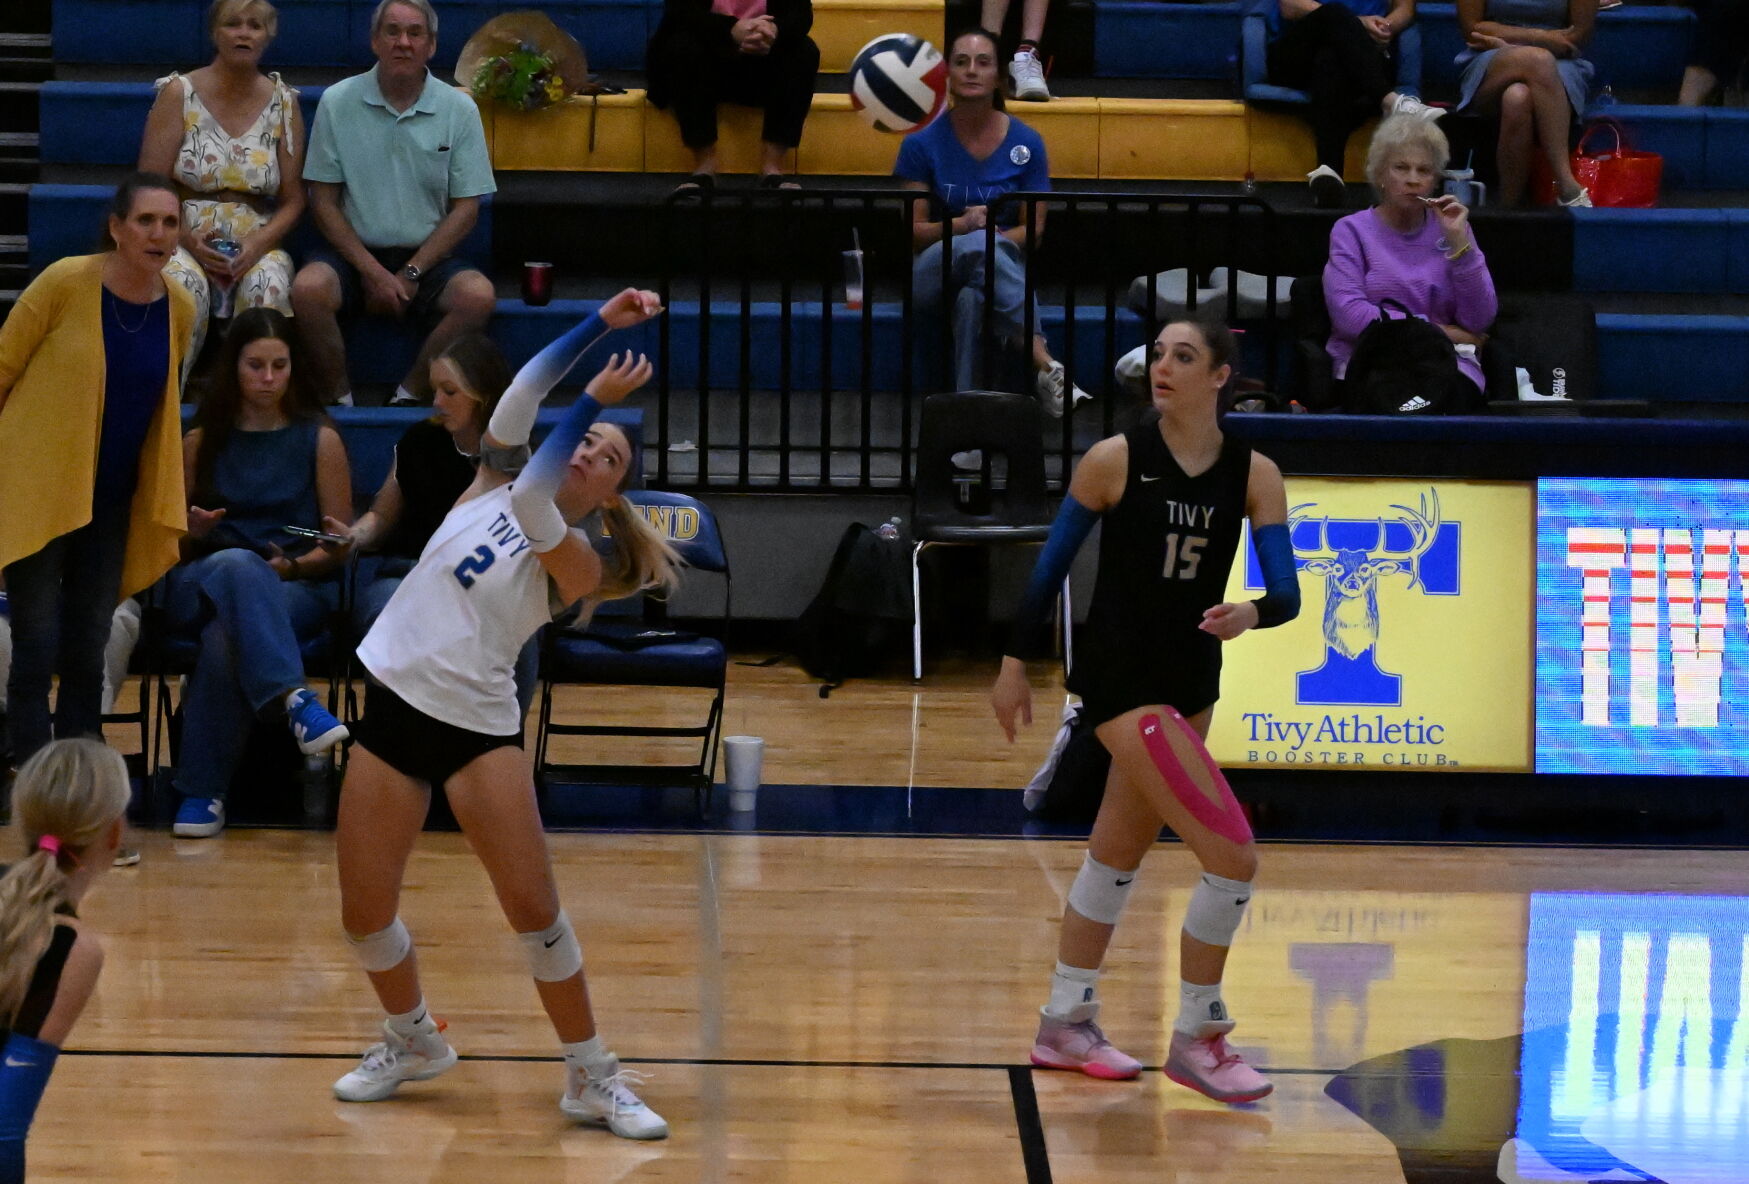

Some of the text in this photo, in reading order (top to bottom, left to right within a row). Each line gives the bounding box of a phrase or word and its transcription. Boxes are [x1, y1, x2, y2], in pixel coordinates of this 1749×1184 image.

[487, 512, 530, 558] TIVY
[1166, 500, 1214, 529] TIVY
[453, 545, 495, 590] 2
[1162, 533, 1208, 579] 15
[1567, 527, 1749, 728] TIV
[1242, 713, 1444, 750] Tivy Athletic
[1248, 751, 1365, 764] BOOSTER
[1382, 753, 1448, 766] CLUB
